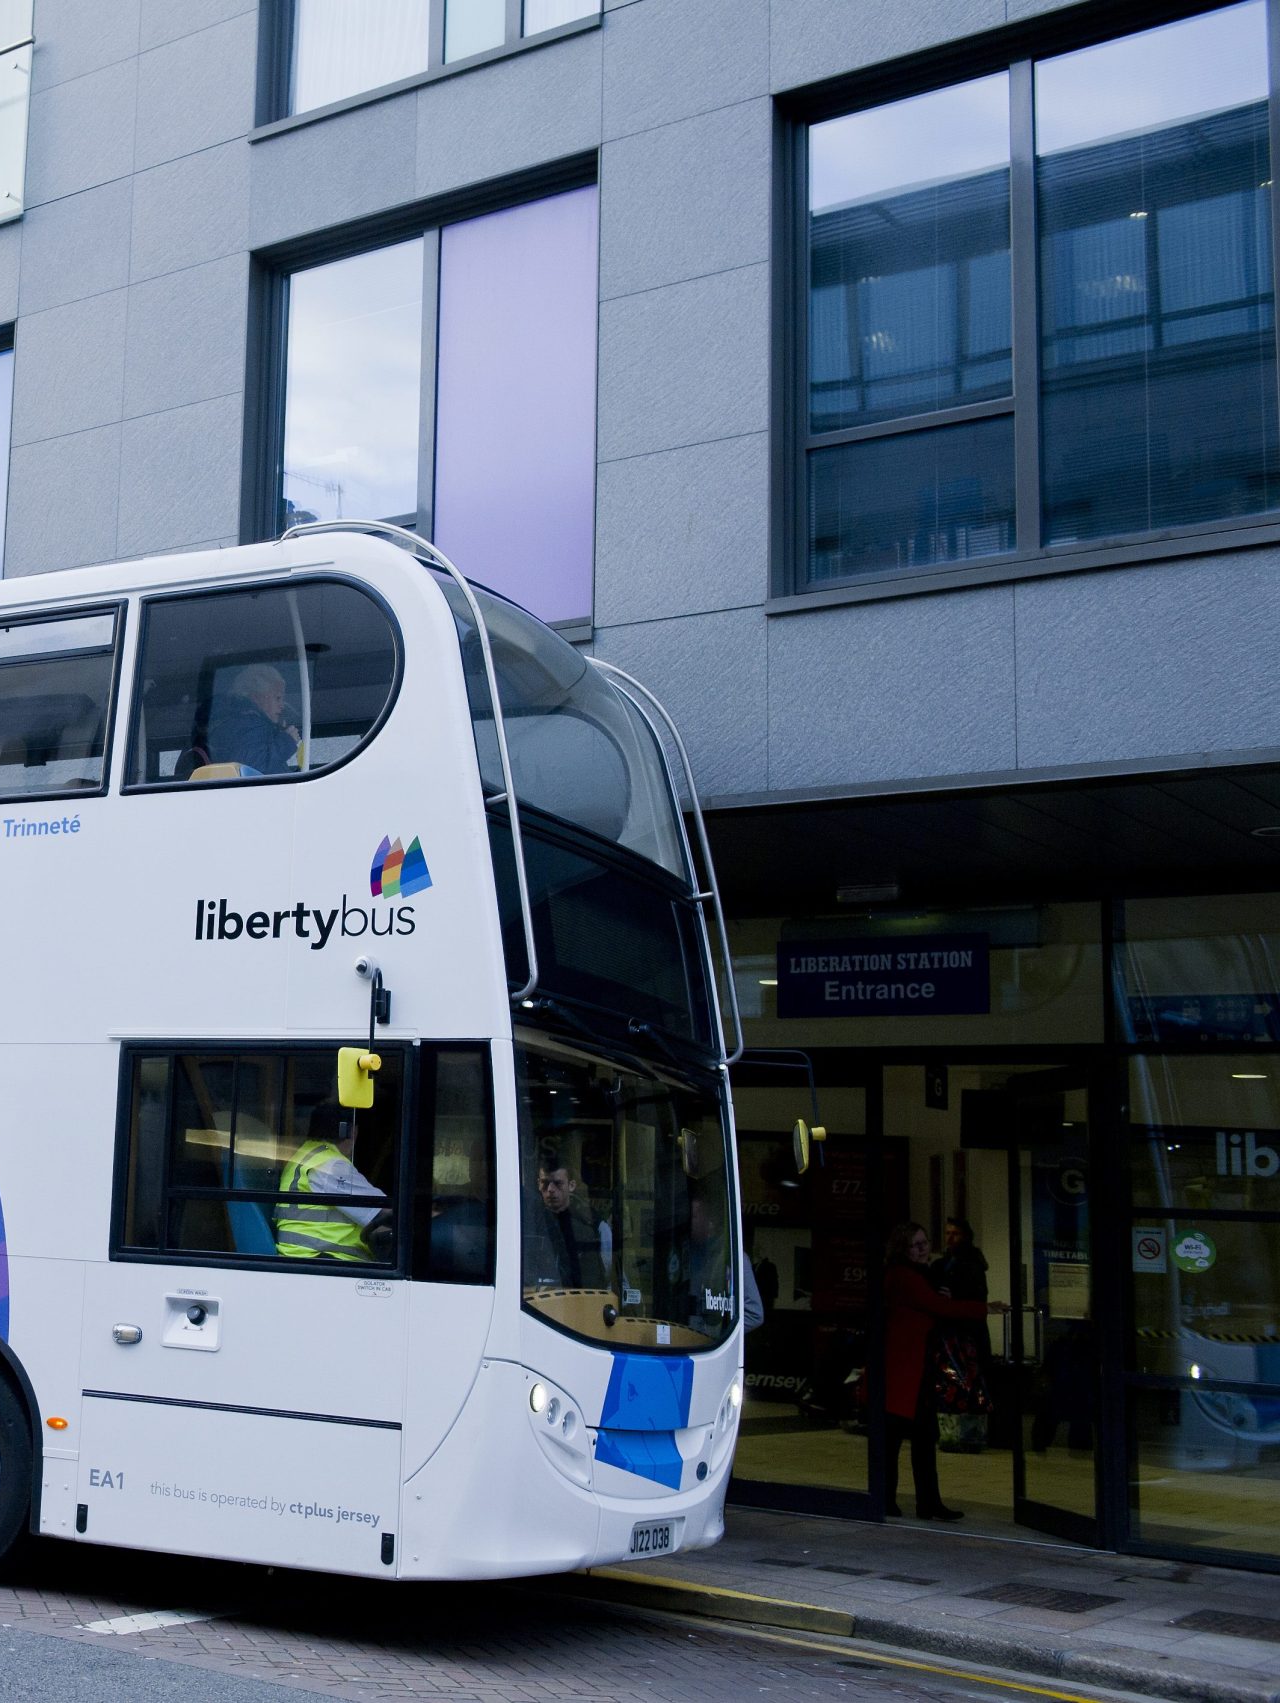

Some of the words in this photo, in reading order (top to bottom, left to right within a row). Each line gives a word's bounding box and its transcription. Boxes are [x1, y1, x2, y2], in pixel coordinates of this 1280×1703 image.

[3, 814, 81, 837] Trinneté
[195, 894, 416, 950] libertybus
[789, 954, 892, 974] LIBERATION
[897, 950, 973, 970] STATION
[824, 981, 935, 1001] Entrance
[1216, 1131, 1280, 1177] lib
[1061, 1168, 1086, 1195] G
[744, 1201, 781, 1215] nce
[1042, 1250, 1089, 1260] TIMETABL
[745, 1373, 807, 1393] ernsey
[89, 1468, 125, 1490] EA1
[150, 1481, 171, 1498] this
[173, 1484, 195, 1500] bus
[198, 1488, 207, 1502] is
[210, 1492, 267, 1510] operated
[271, 1496, 286, 1515] by
[336, 1506, 380, 1528] jersey
